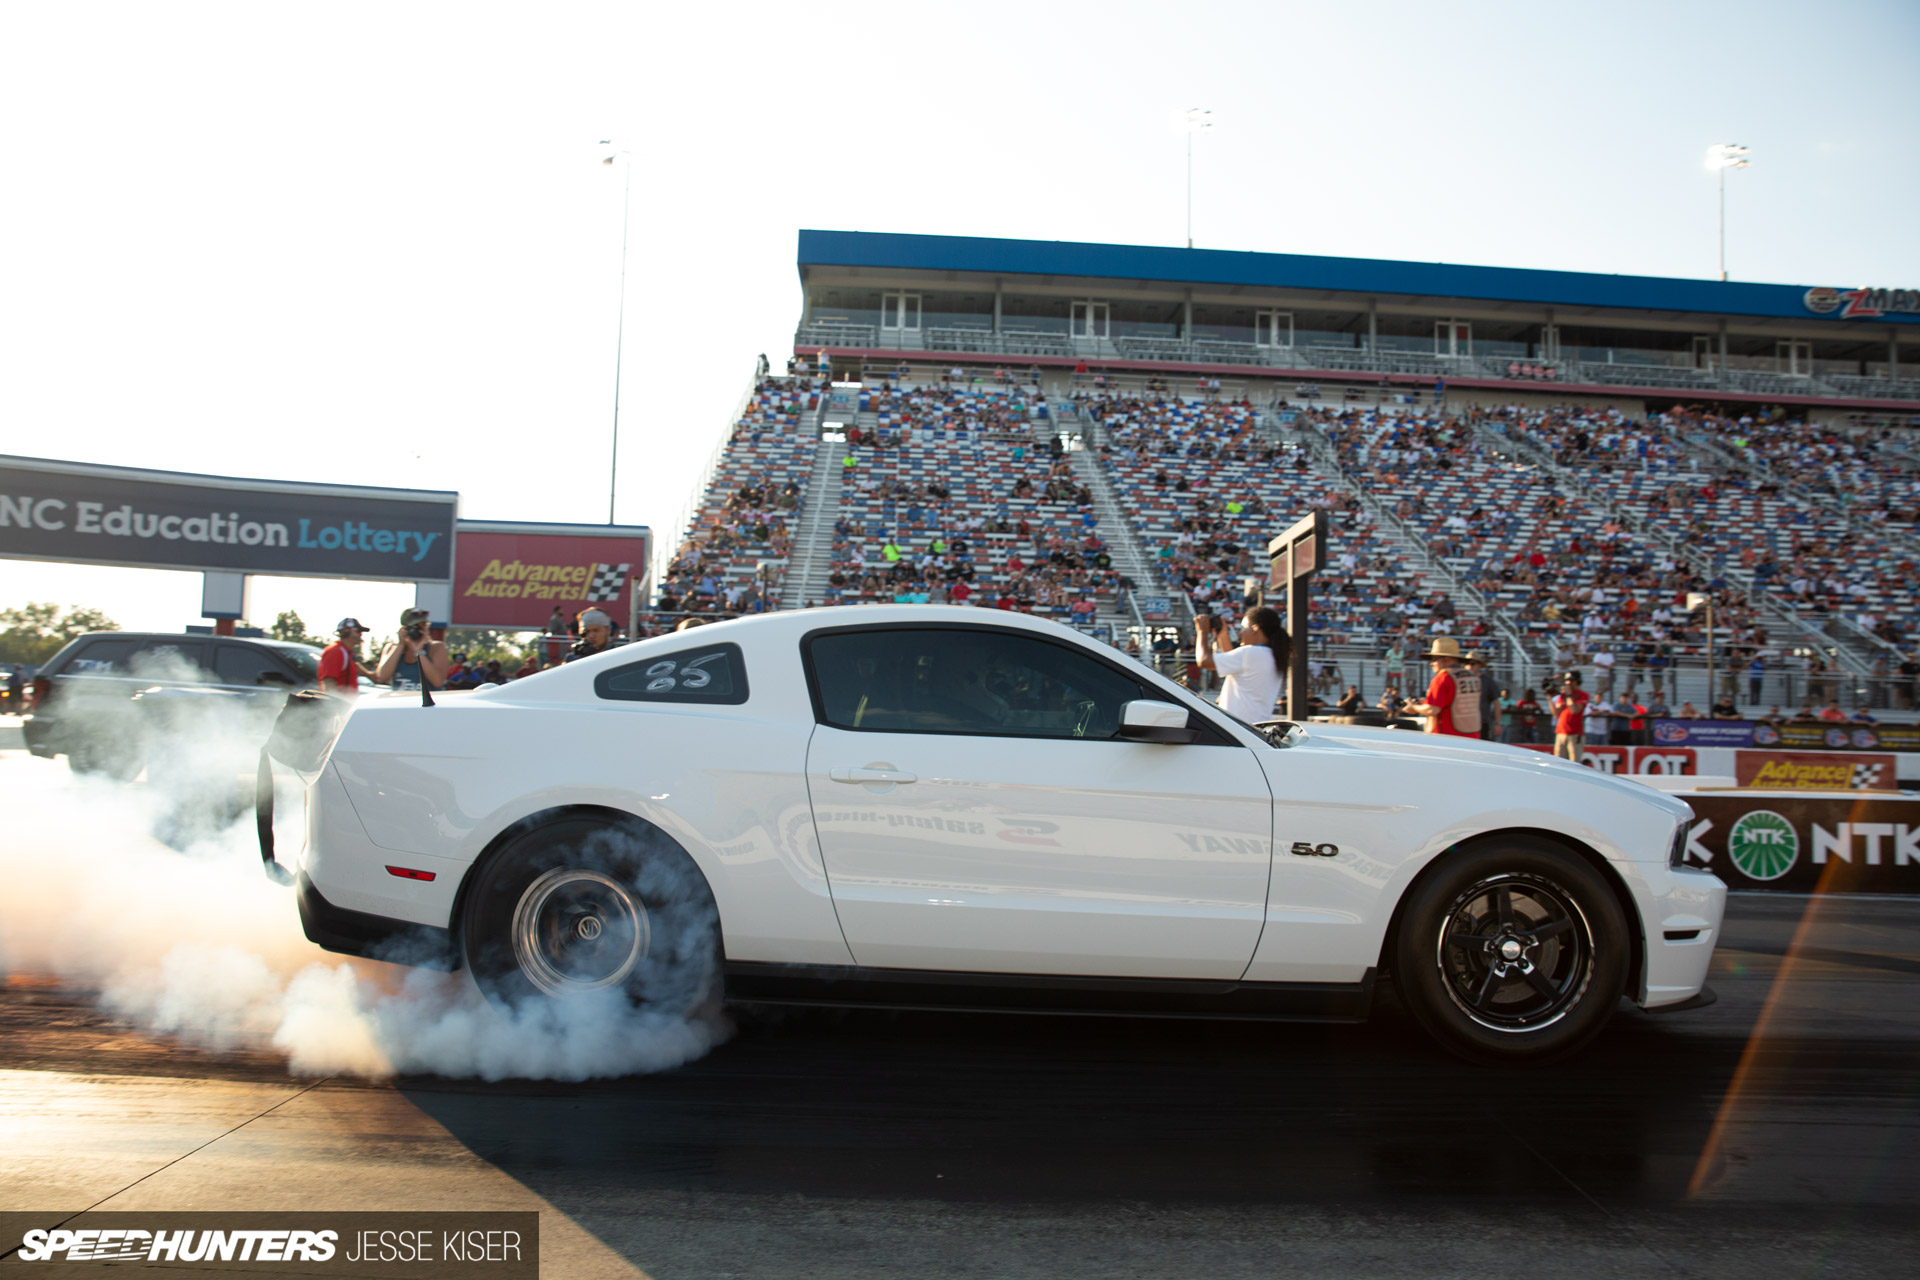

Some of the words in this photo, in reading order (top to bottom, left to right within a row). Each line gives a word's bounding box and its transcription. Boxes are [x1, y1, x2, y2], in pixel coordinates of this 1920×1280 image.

[0, 494, 67, 531] NC
[75, 502, 289, 547] Education
[297, 518, 438, 563] Lottery
[478, 559, 587, 583] Advance
[463, 579, 521, 598] Auto
[521, 581, 581, 600] Parts
[1757, 761, 1847, 780] Advance
[1743, 828, 1787, 845] NTK
[1811, 821, 1920, 866] NTK
[1291, 842, 1339, 857] 5.0
